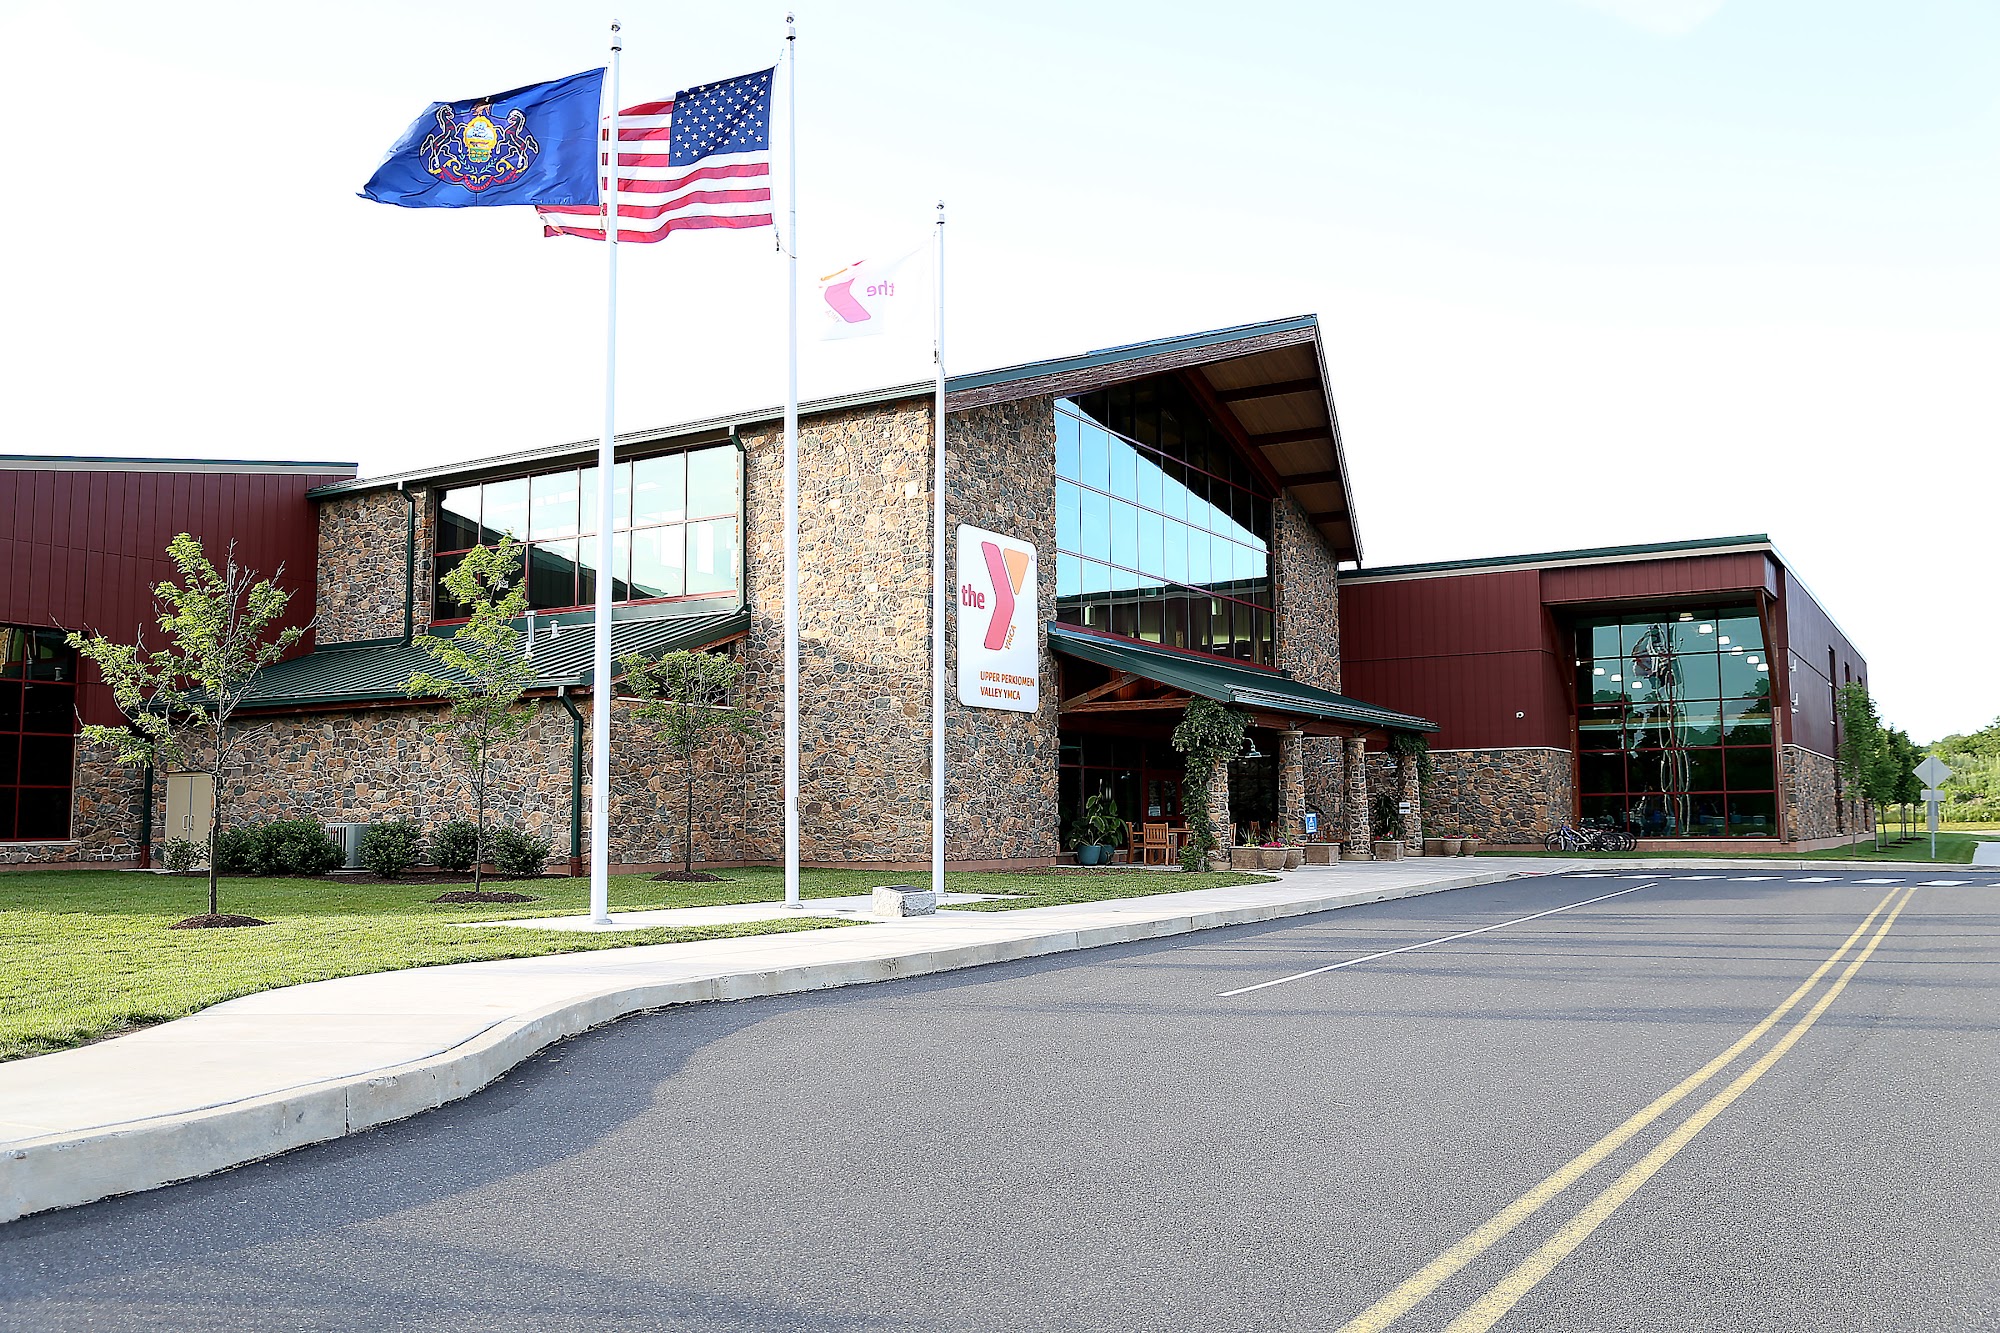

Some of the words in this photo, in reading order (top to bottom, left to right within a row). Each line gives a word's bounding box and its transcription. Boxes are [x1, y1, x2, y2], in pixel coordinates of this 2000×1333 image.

[961, 584, 985, 610] the
[1004, 624, 1017, 650] YMCA
[980, 670, 1001, 683] UPPER
[1001, 673, 1035, 687] PERKIOMEN
[980, 686, 1003, 698] VALLEY
[1003, 689, 1021, 700] YMCA
